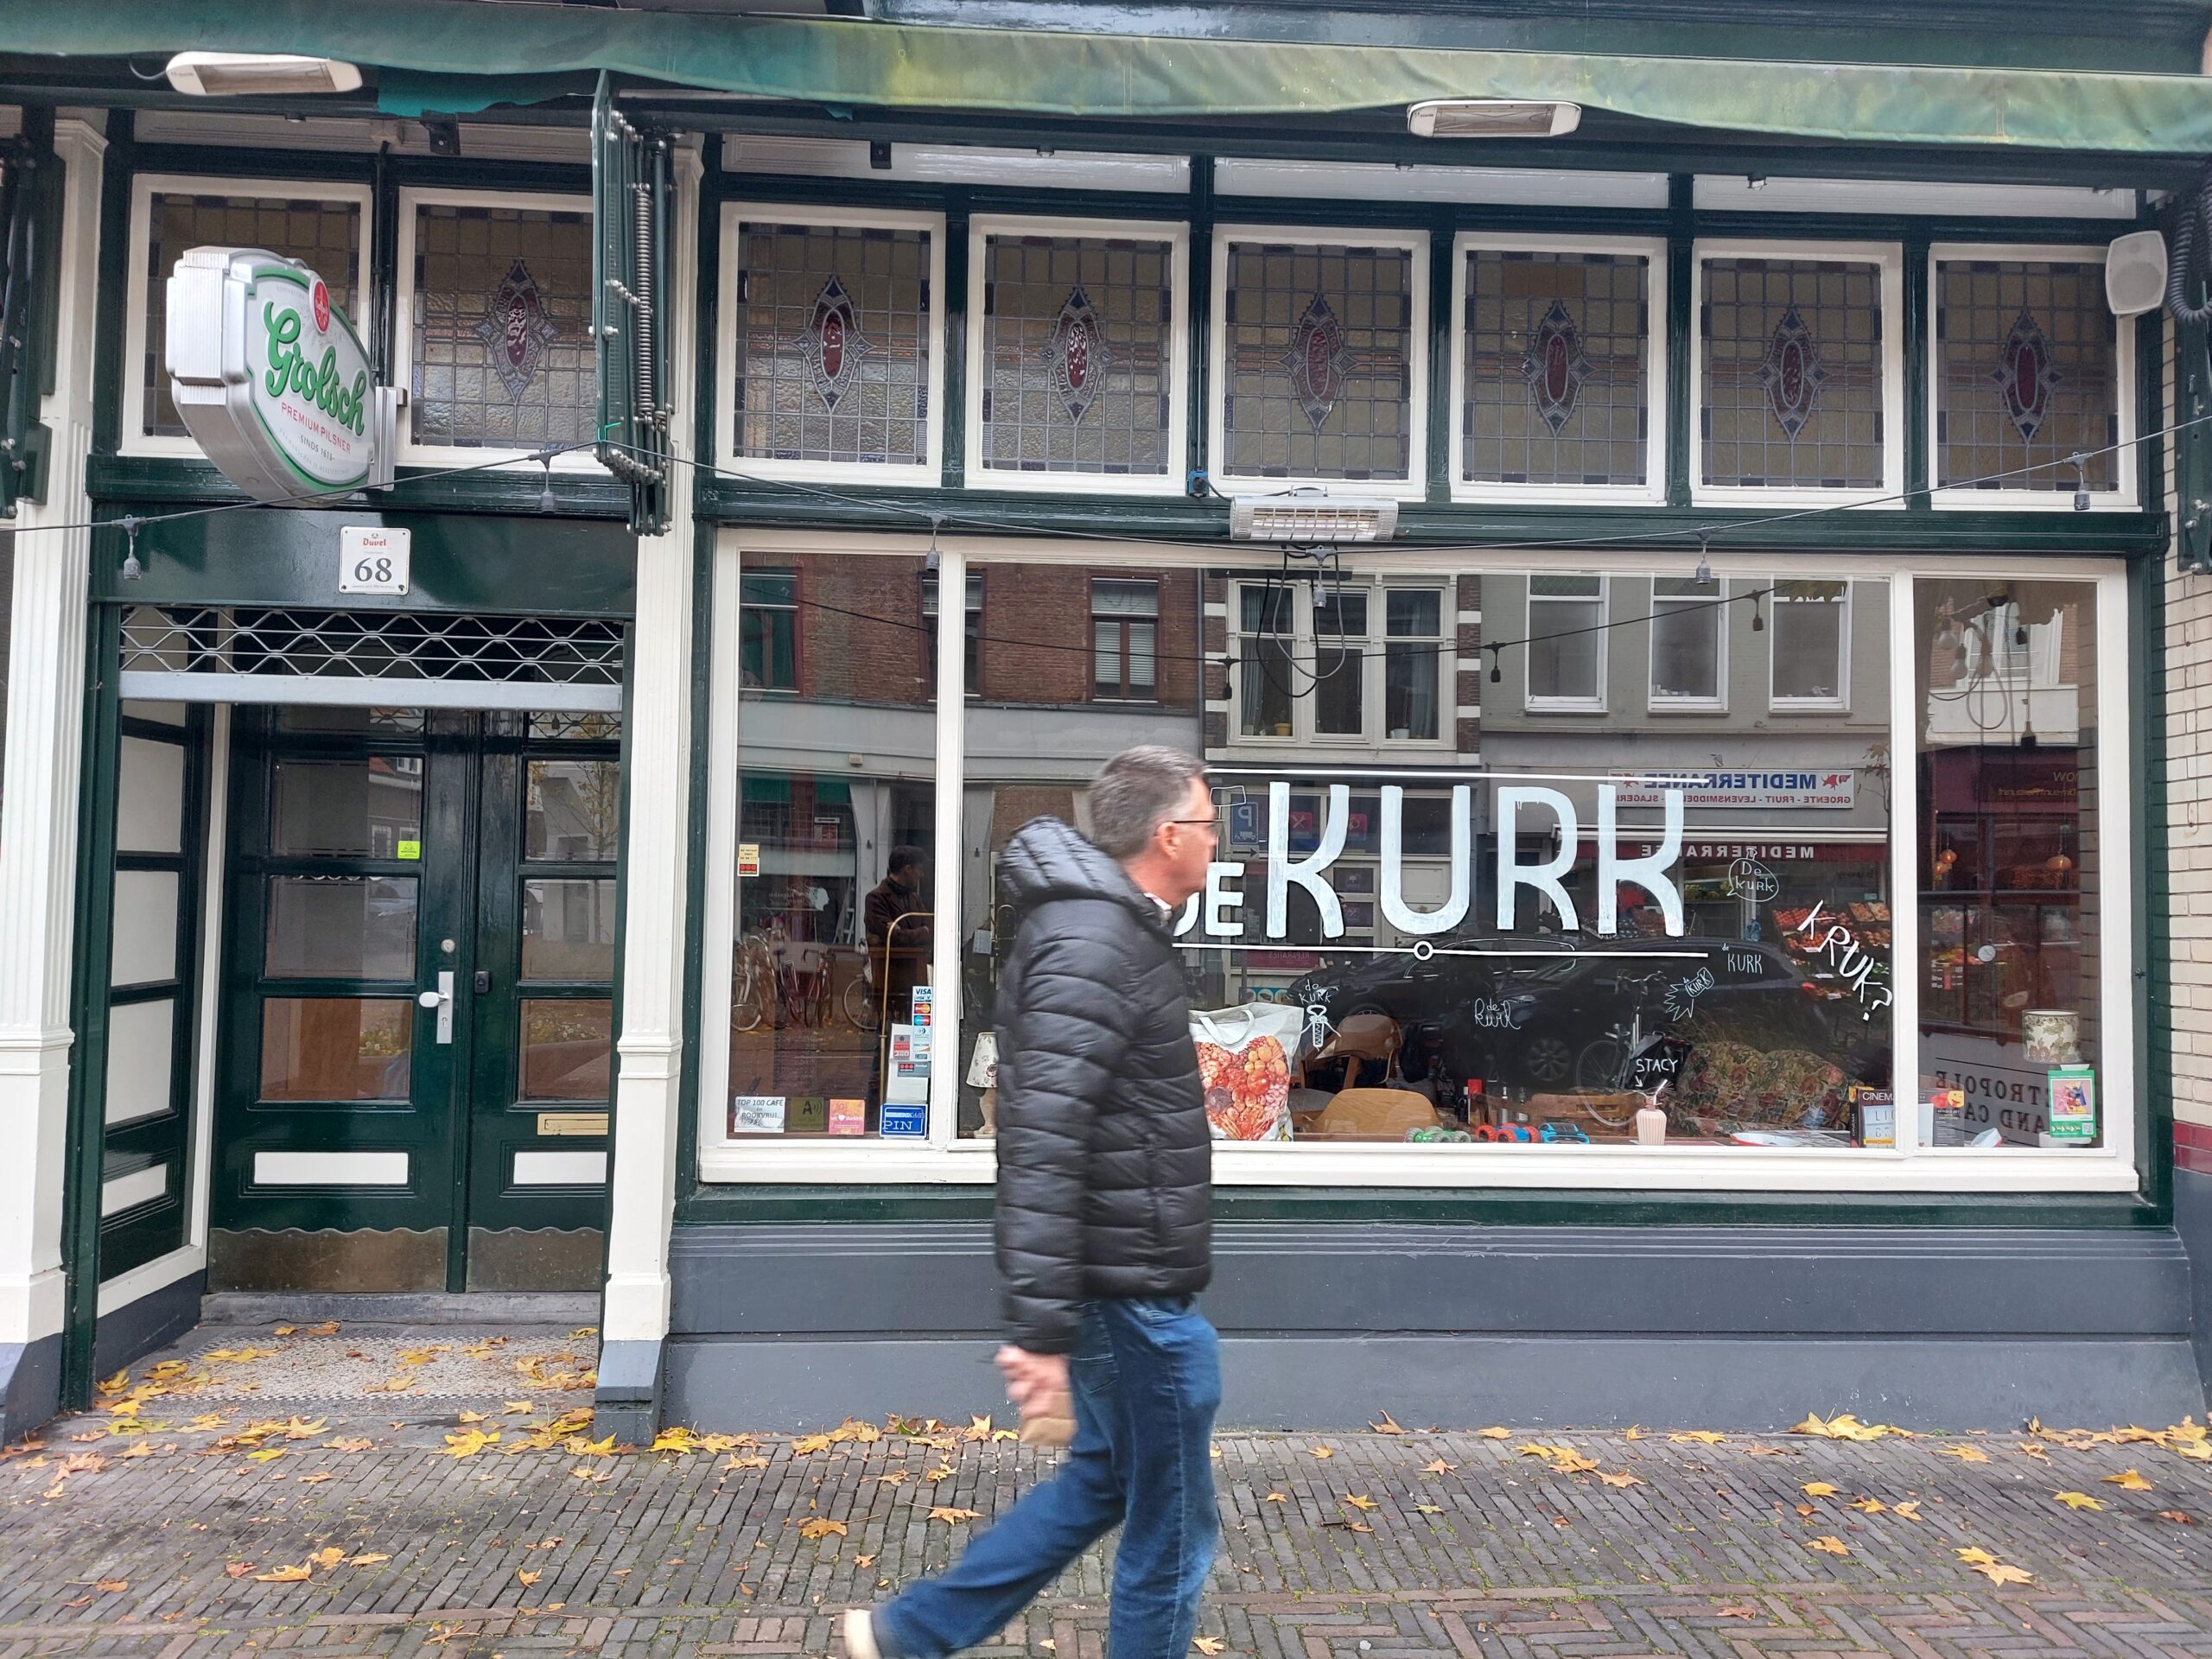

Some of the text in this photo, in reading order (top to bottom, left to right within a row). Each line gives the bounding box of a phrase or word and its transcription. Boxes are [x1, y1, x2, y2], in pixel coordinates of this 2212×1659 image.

[264, 301, 366, 437] Grolsch
[281, 402, 351, 454] PREMIUM PILSNER
[363, 537, 387, 547] Duvel
[354, 557, 392, 582] 68
[1267, 781, 1684, 938] KURK
[1741, 861, 1762, 876] De
[1722, 942, 1729, 951] de
[1728, 953, 1763, 975] KURK
[1797, 899, 1893, 1022] KRUK?
[1305, 979, 1320, 991] de
[1687, 969, 1712, 995] KURK
[1636, 1058, 1679, 1073] STACY
[1862, 1091, 1894, 1101] CINEM
[882, 1121, 913, 1130] PIN
